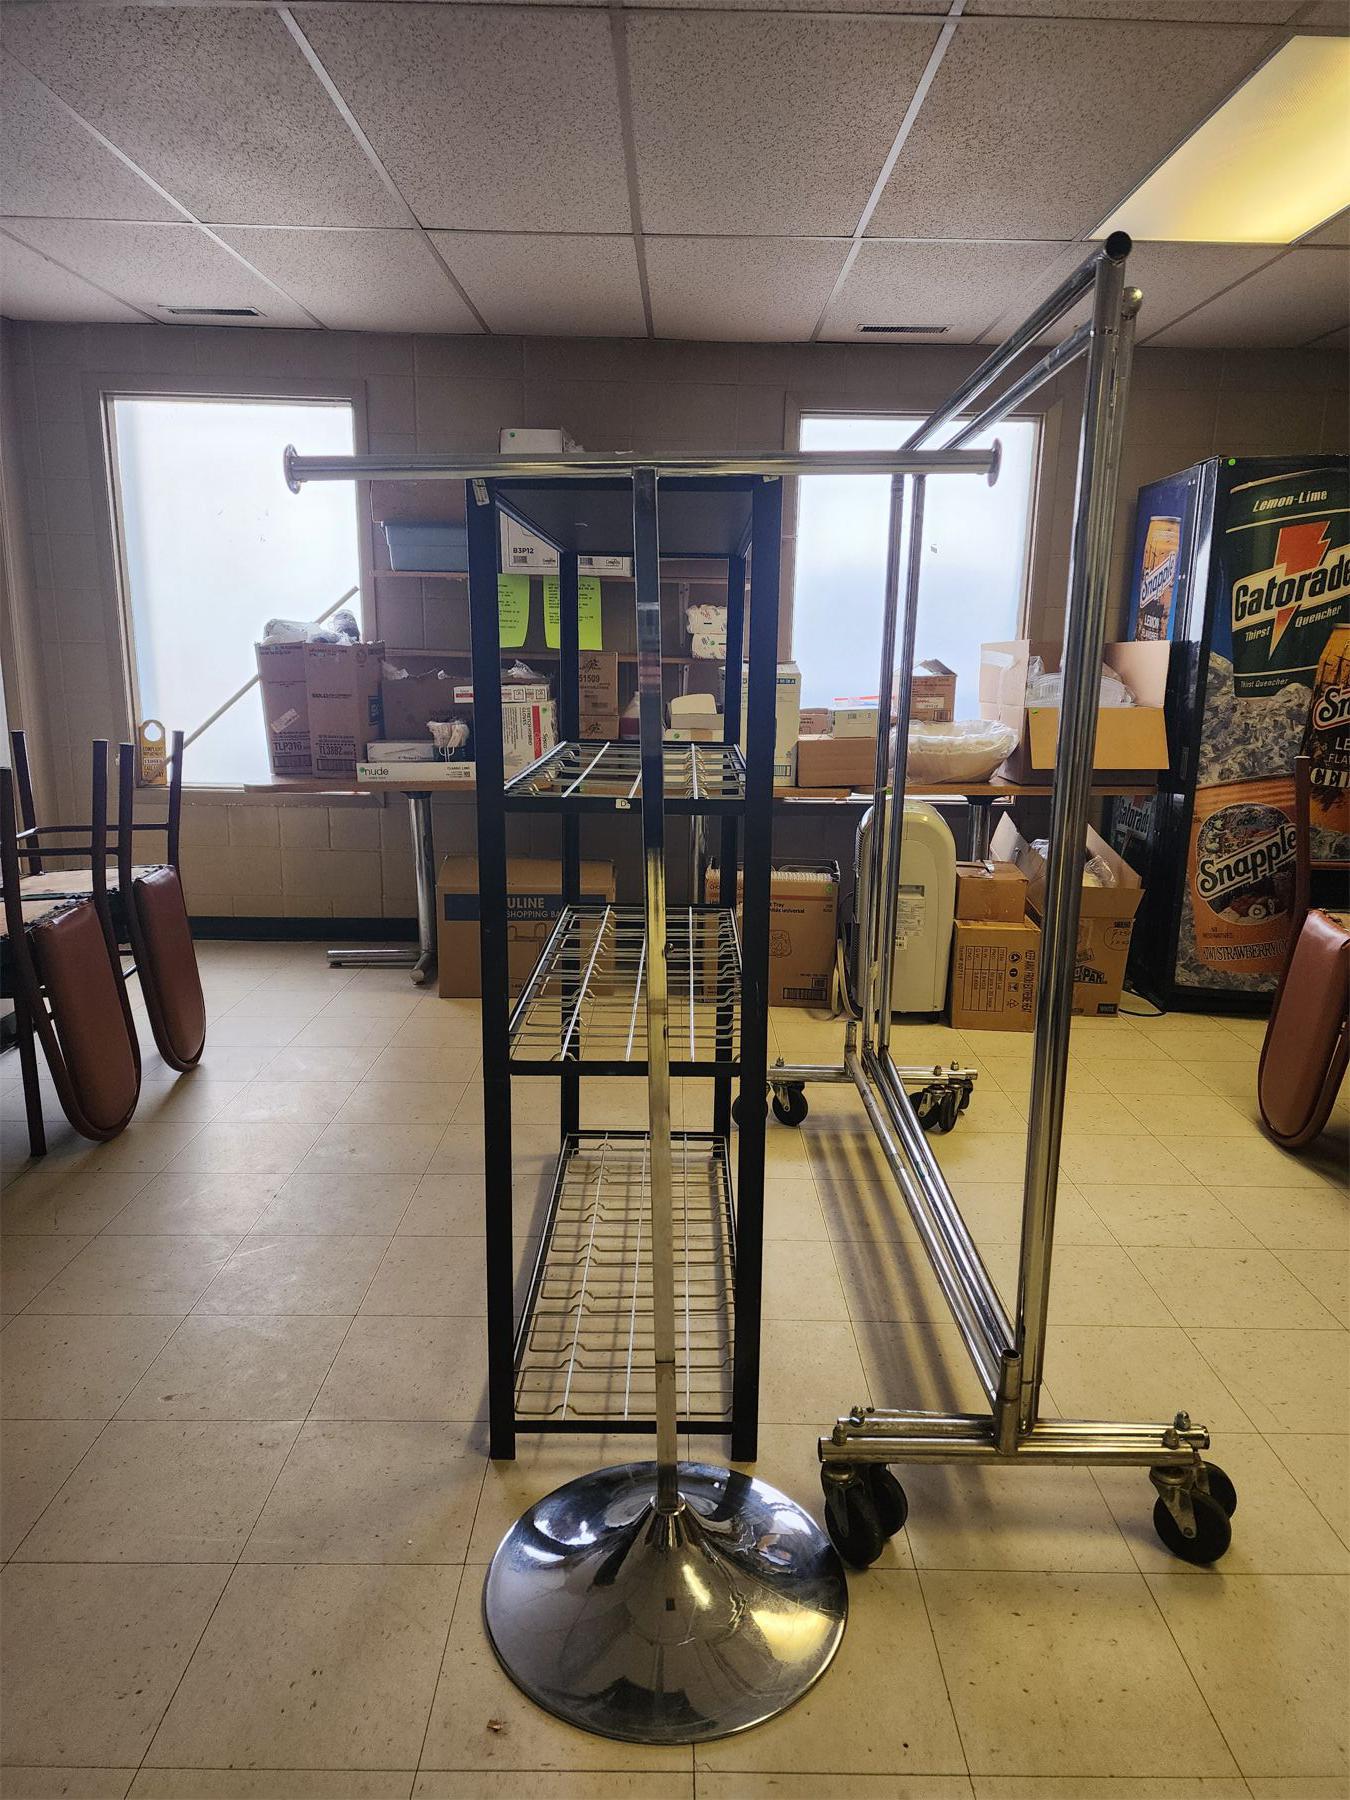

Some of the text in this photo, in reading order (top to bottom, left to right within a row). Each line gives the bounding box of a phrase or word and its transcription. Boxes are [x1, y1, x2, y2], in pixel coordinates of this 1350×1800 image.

[1252, 490, 1328, 513] Lemon-Lime
[1234, 554, 1350, 622] Gatorade
[1245, 605, 1342, 642] Thirst Quencher
[1240, 677, 1289, 688] Thirst Quencher
[364, 766, 389, 776] nude
[1200, 826, 1296, 893] Snapple
[507, 897, 544, 909] ULINE
[506, 909, 549, 919] SHOPPING
